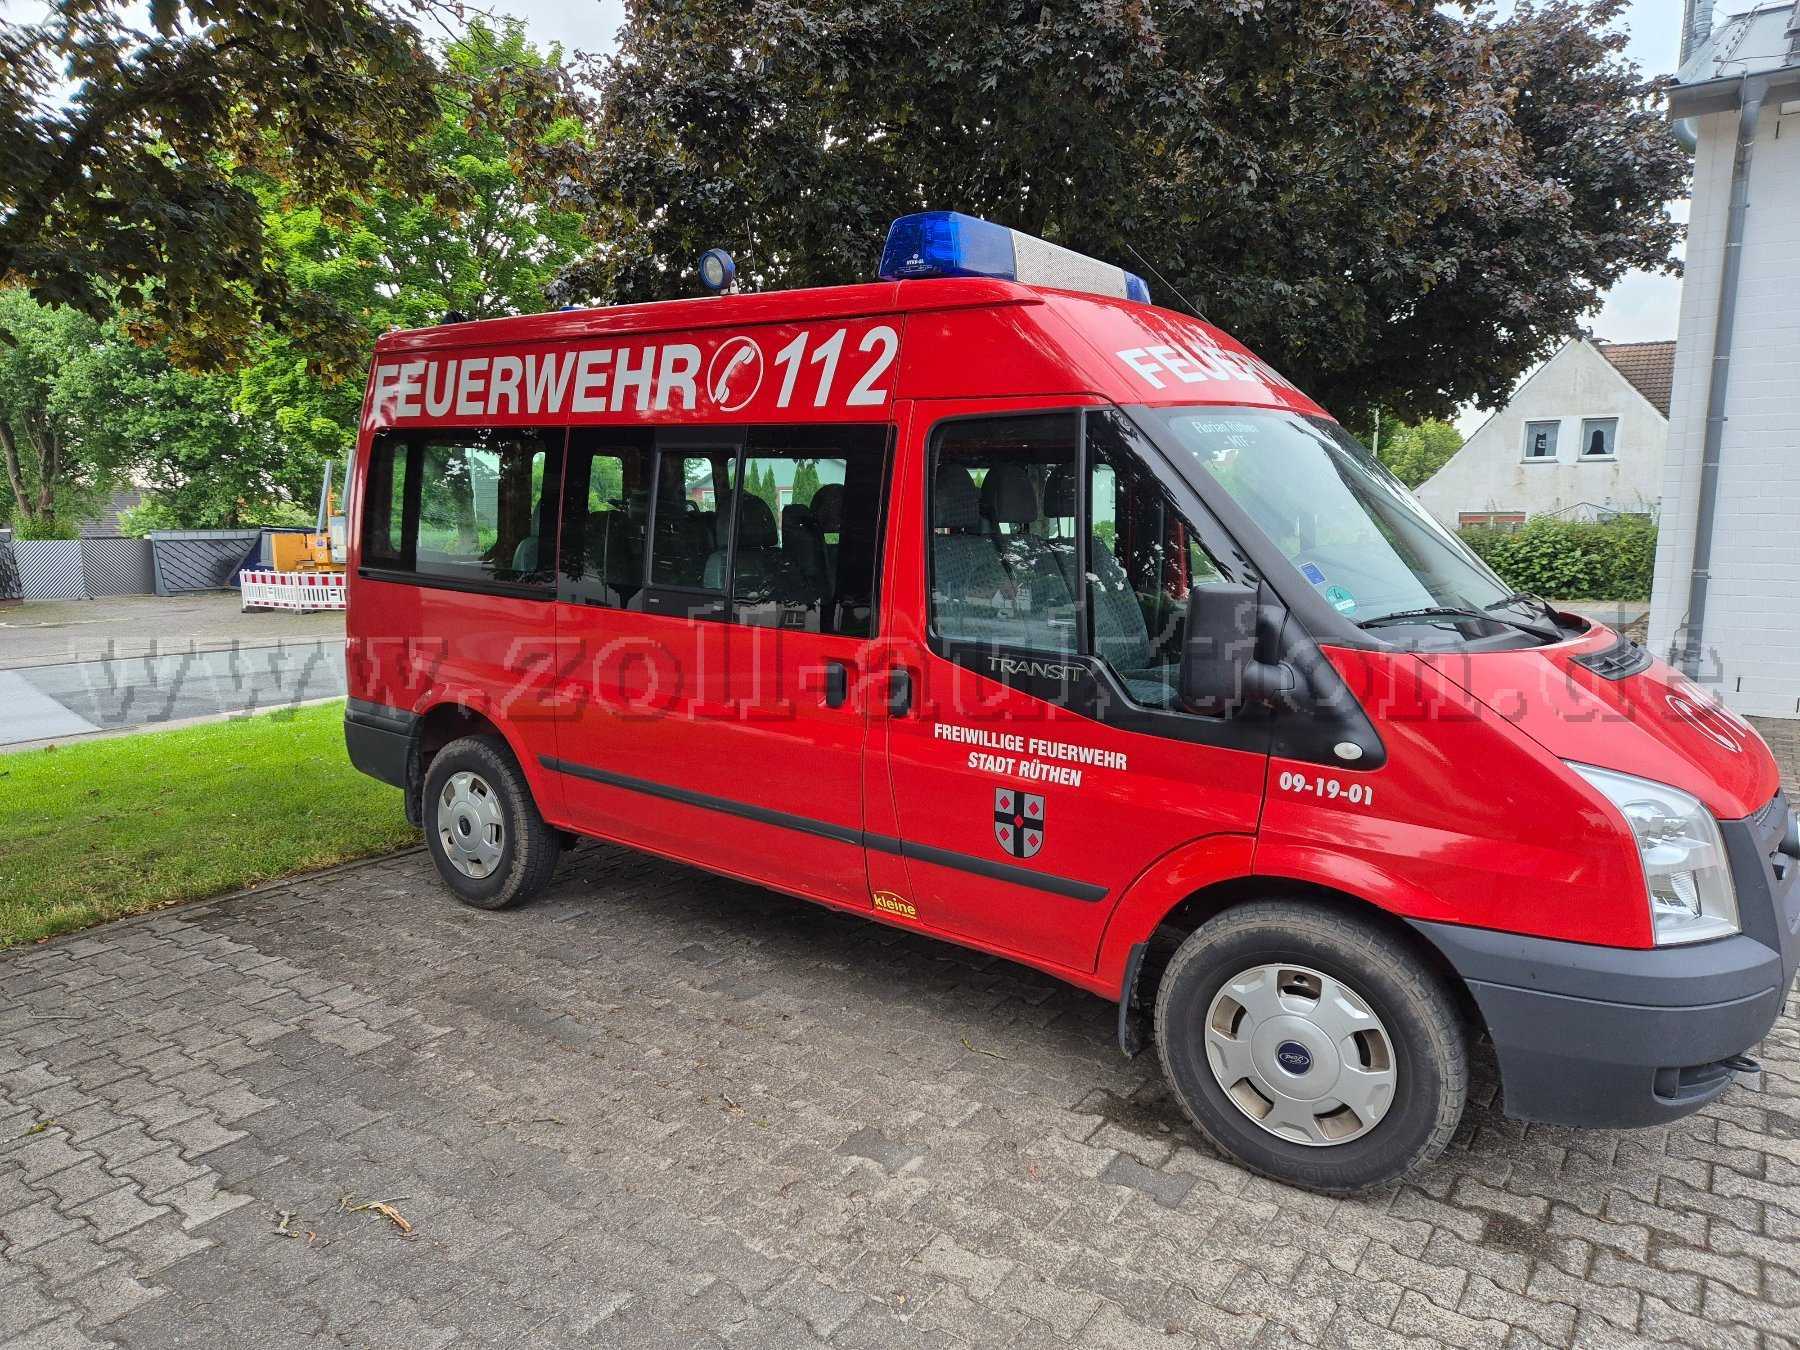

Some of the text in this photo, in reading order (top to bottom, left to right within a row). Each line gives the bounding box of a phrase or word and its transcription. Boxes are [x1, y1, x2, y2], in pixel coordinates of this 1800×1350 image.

[373, 326, 899, 417] FEUERWEHR 112
[987, 656, 1086, 682] TRANSIT
[934, 722, 1128, 770] FREIWILLIGE FEUERWEHR
[967, 751, 1082, 787] STADT RÜTHEN
[1279, 771, 1373, 806] 09-19-01
[873, 893, 916, 915] kleine
